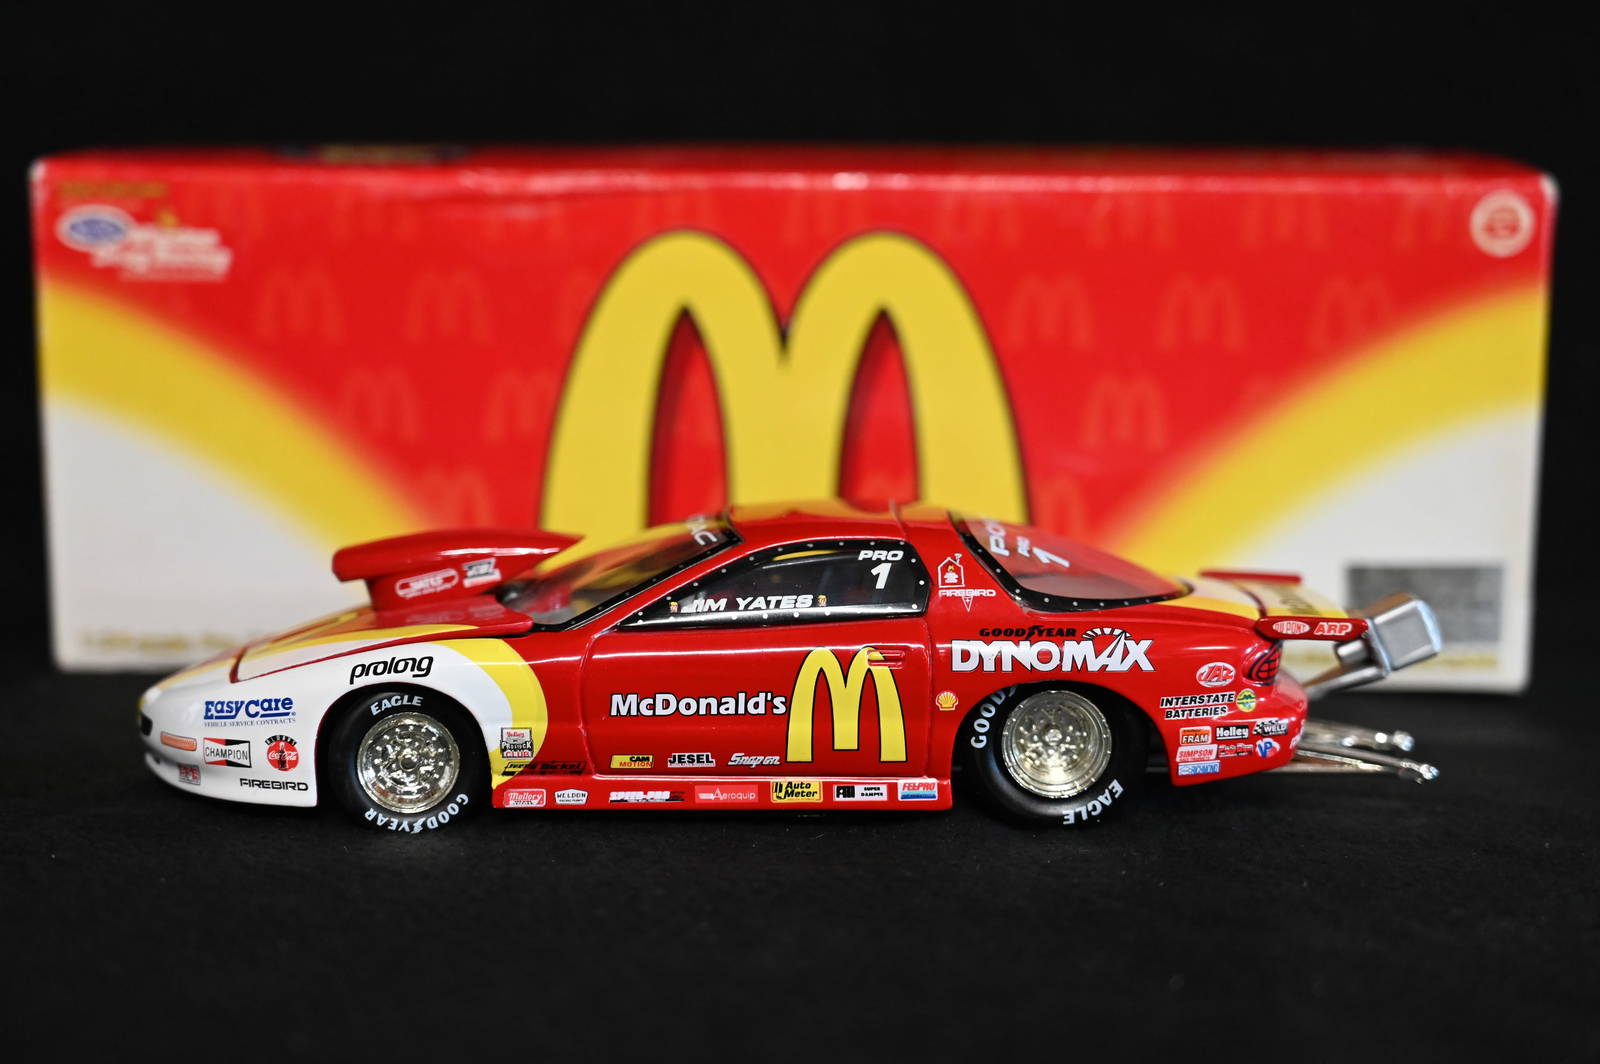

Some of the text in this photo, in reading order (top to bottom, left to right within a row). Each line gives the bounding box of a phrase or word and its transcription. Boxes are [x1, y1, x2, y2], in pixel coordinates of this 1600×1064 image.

[858, 550, 904, 561] PRO
[870, 563, 892, 590] 1
[938, 589, 997, 598] FIREBIRD
[735, 594, 814, 611] YATES
[1313, 623, 1350, 635] ARP
[951, 630, 1156, 673] DYNOMAX
[349, 656, 434, 685] prolong
[370, 694, 424, 716] EAGLE
[609, 692, 788, 718] McDonald's
[1160, 692, 1236, 708] INTERSTATE
[1164, 706, 1228, 719] BATTERIES
[1216, 726, 1250, 739] Holley
[1263, 723, 1287, 733] WELD
[1182, 734, 1210, 745] FRAM
[205, 747, 249, 760] CHAMPION
[668, 753, 714, 764] JESEL
[1178, 747, 1214, 758] SIMPSON
[239, 778, 309, 792] FIREBIRD
[784, 781, 812, 790] Auto
[712, 787, 757, 800] Aeroquip
[783, 788, 818, 799] Meter
[1062, 779, 1125, 825] EAGLE
